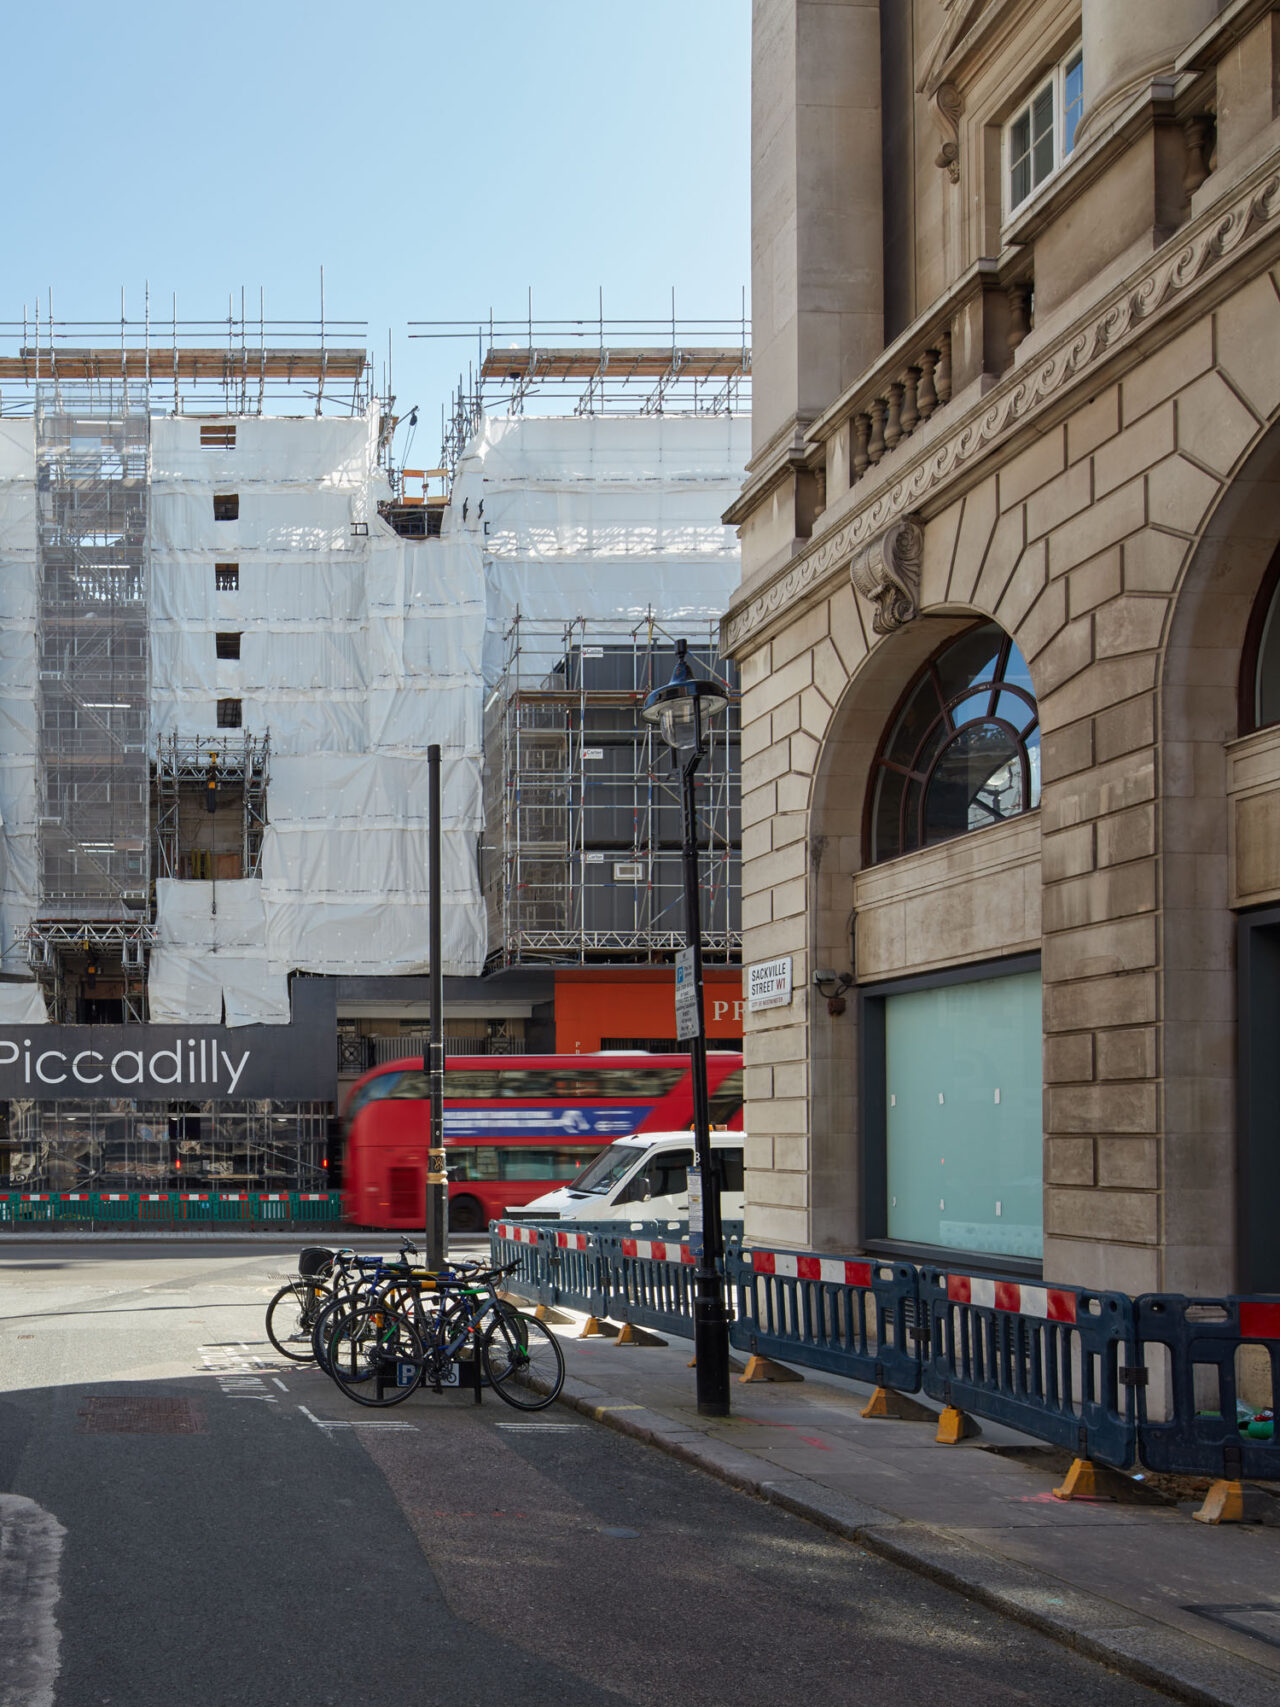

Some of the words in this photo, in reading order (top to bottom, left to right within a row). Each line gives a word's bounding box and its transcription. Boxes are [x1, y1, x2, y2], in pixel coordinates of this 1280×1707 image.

[751, 962, 786, 981] SACKVILLE
[751, 980, 774, 996] STREET
[775, 977, 786, 990] W1
[401, 1363, 417, 1384] P
